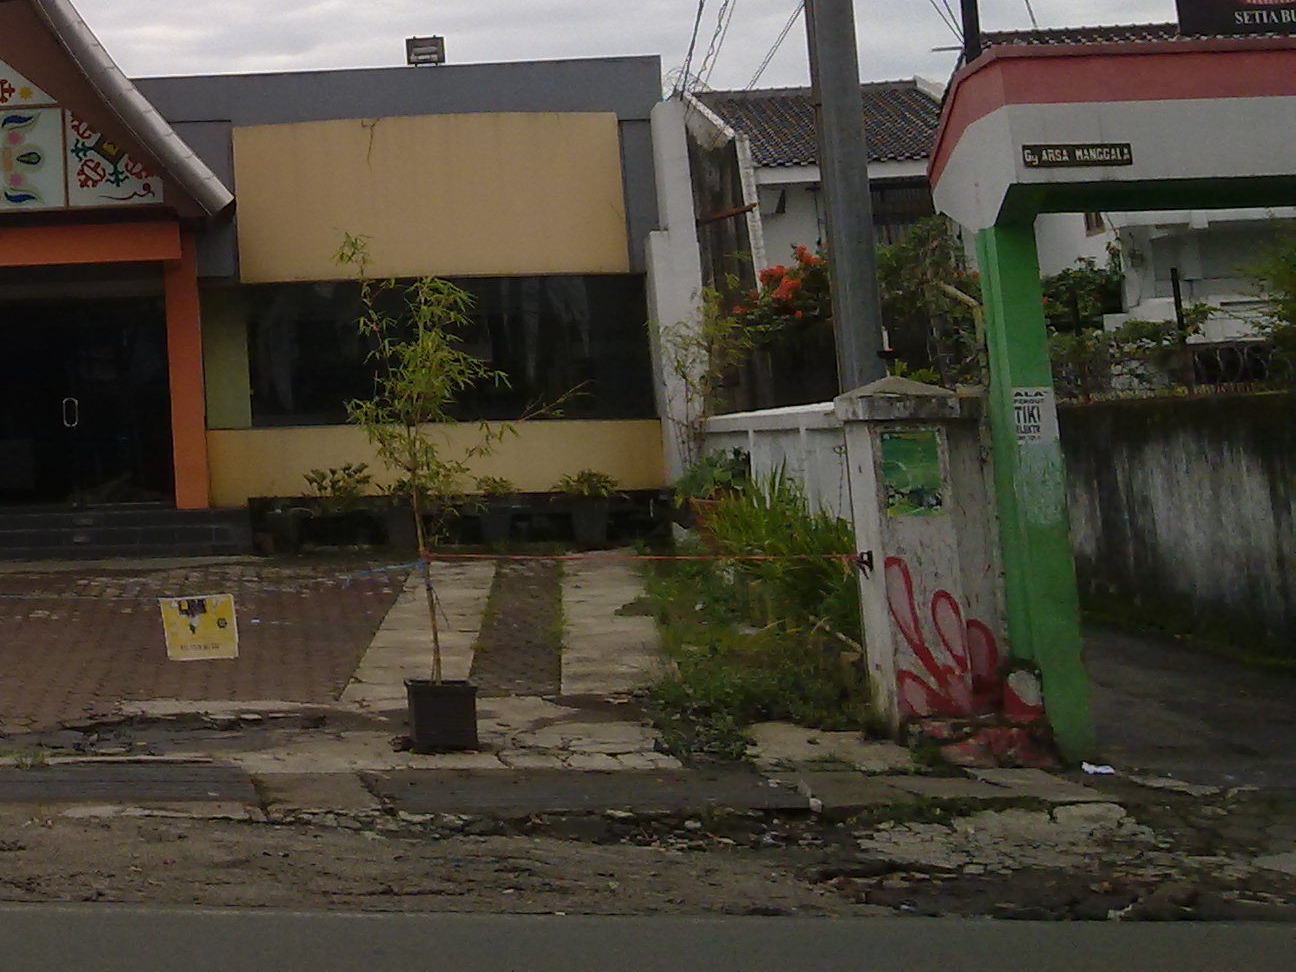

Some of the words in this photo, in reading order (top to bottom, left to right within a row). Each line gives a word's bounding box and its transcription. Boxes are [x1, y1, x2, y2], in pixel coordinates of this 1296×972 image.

[1234, 10, 1279, 25] SETIA
[1041, 148, 1070, 162] ARSA
[1075, 147, 1130, 161] MANGGALA
